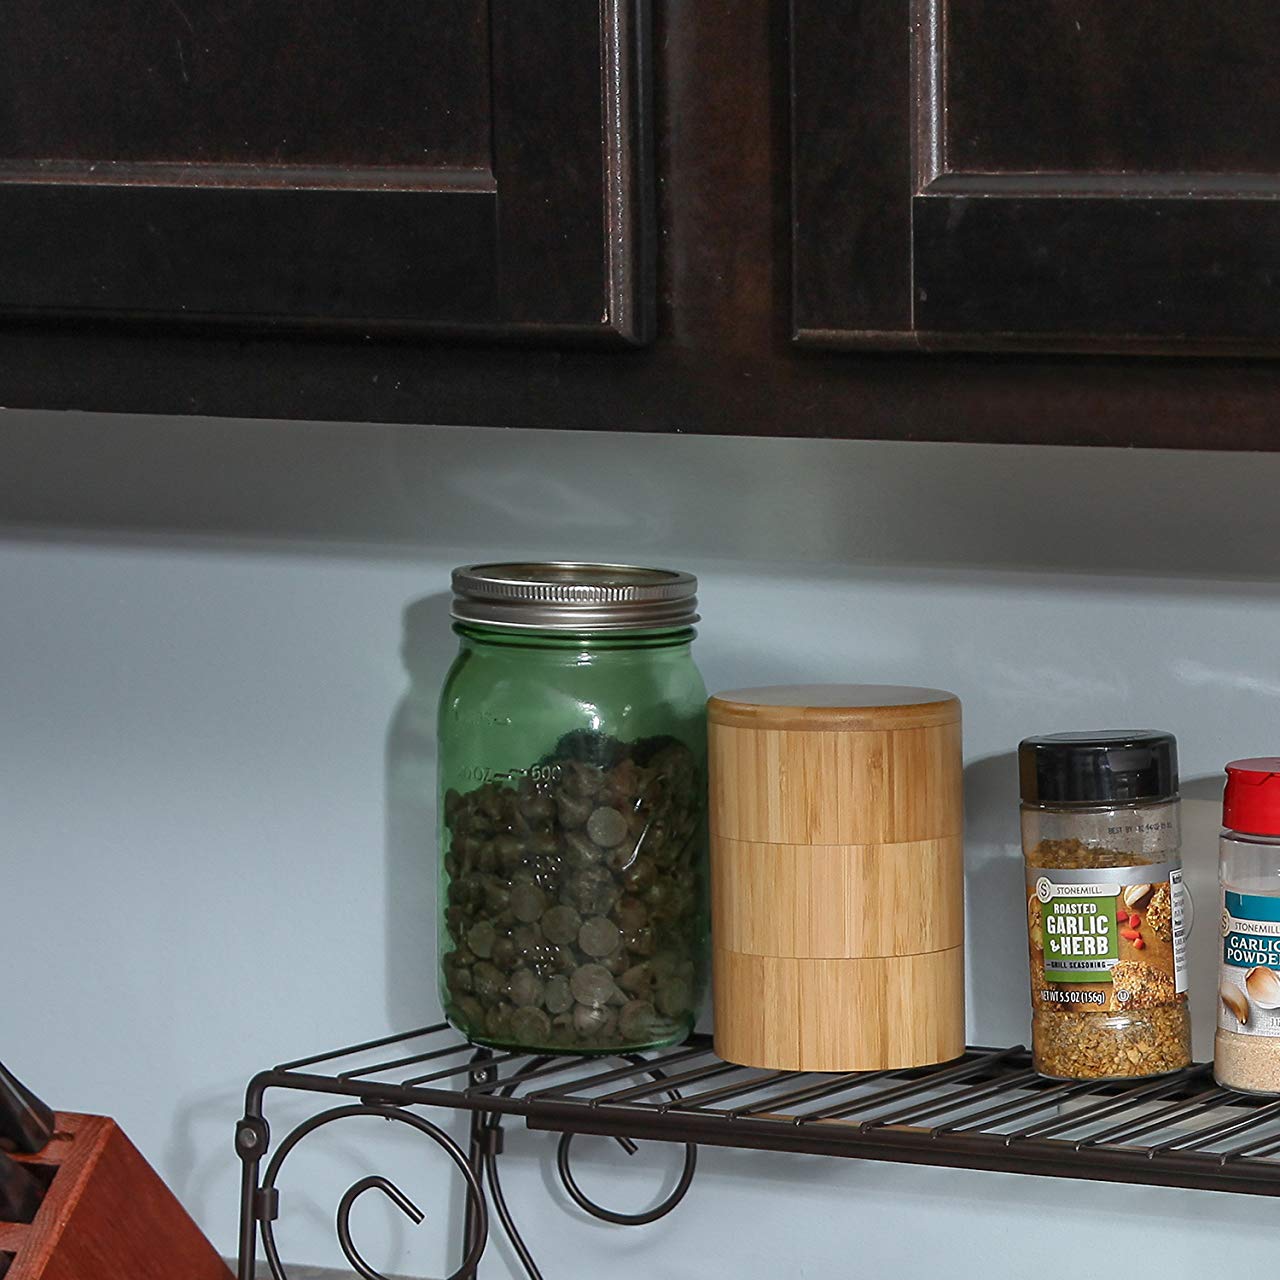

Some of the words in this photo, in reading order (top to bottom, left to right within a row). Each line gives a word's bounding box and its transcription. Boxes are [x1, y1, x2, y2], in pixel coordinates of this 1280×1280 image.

[1053, 903, 1097, 914] ROASTED
[1046, 915, 1109, 935] GARLIC
[1051, 961, 1067, 969] GRILL
[1069, 961, 1106, 969] SEASONING
[1050, 991, 1059, 1002] WT
[1060, 992, 1070, 1002] 5.5
[1070, 992, 1080, 1002] OZ
[1081, 992, 1106, 1004] (156g)
